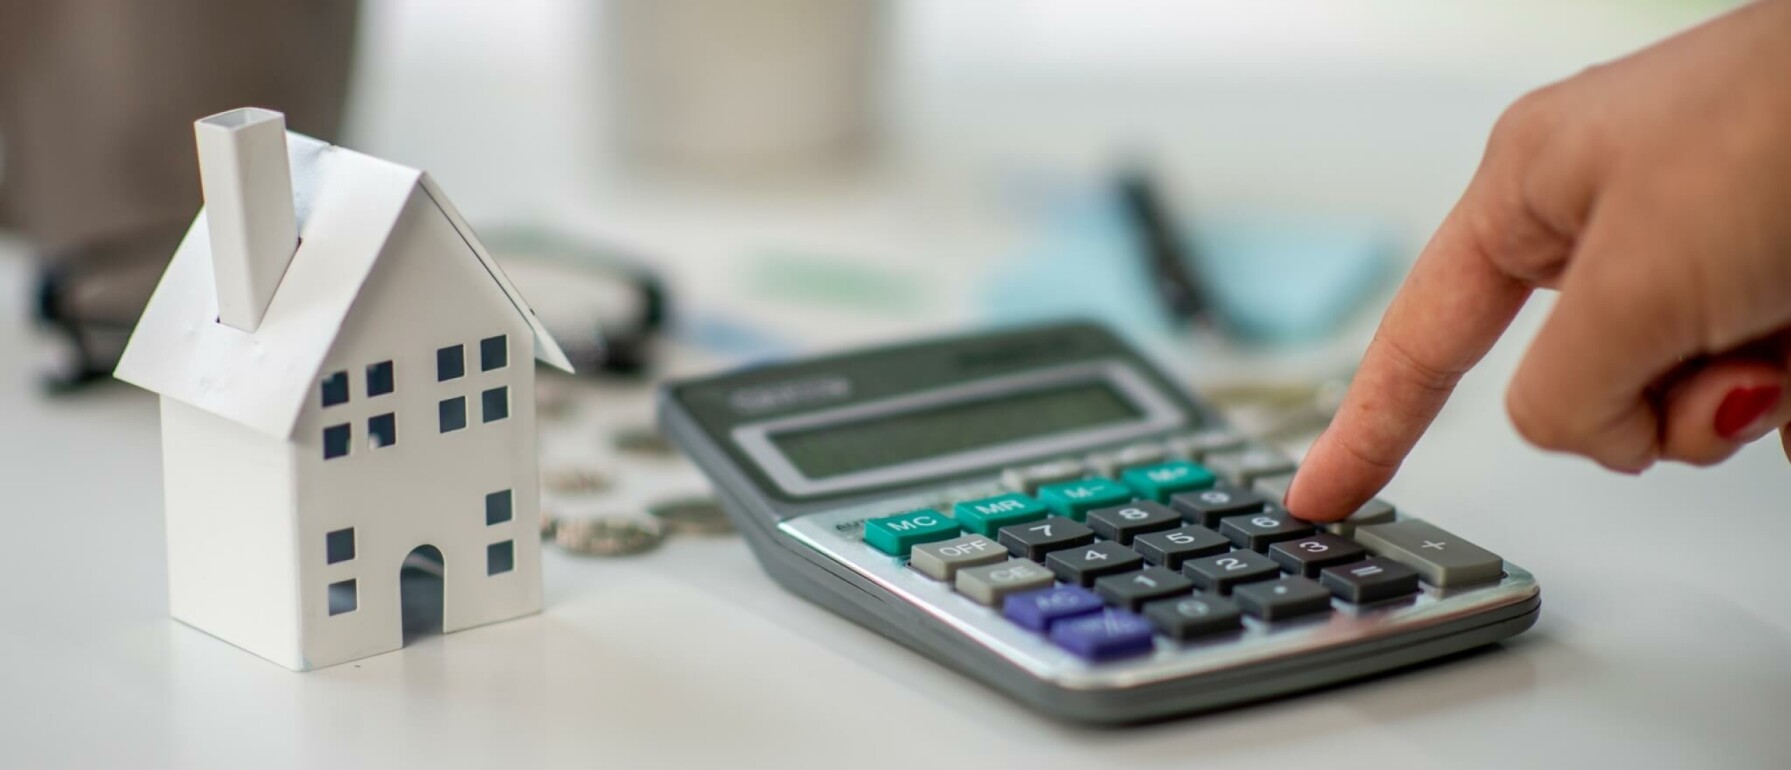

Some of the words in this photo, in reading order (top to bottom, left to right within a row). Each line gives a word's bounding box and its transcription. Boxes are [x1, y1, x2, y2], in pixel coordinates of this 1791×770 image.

[975, 499, 1025, 515] MR
[1118, 508, 1148, 520] 8
[885, 515, 938, 532] MC
[1251, 516, 1279, 528] 6
[1028, 524, 1053, 537] 7
[1165, 532, 1195, 545] 5
[938, 540, 988, 557] OFF
[1299, 540, 1329, 553] 3
[1084, 550, 1109, 562] 4
[1216, 556, 1248, 571] 2
[989, 565, 1036, 582] CE
[1133, 575, 1158, 589] 1
